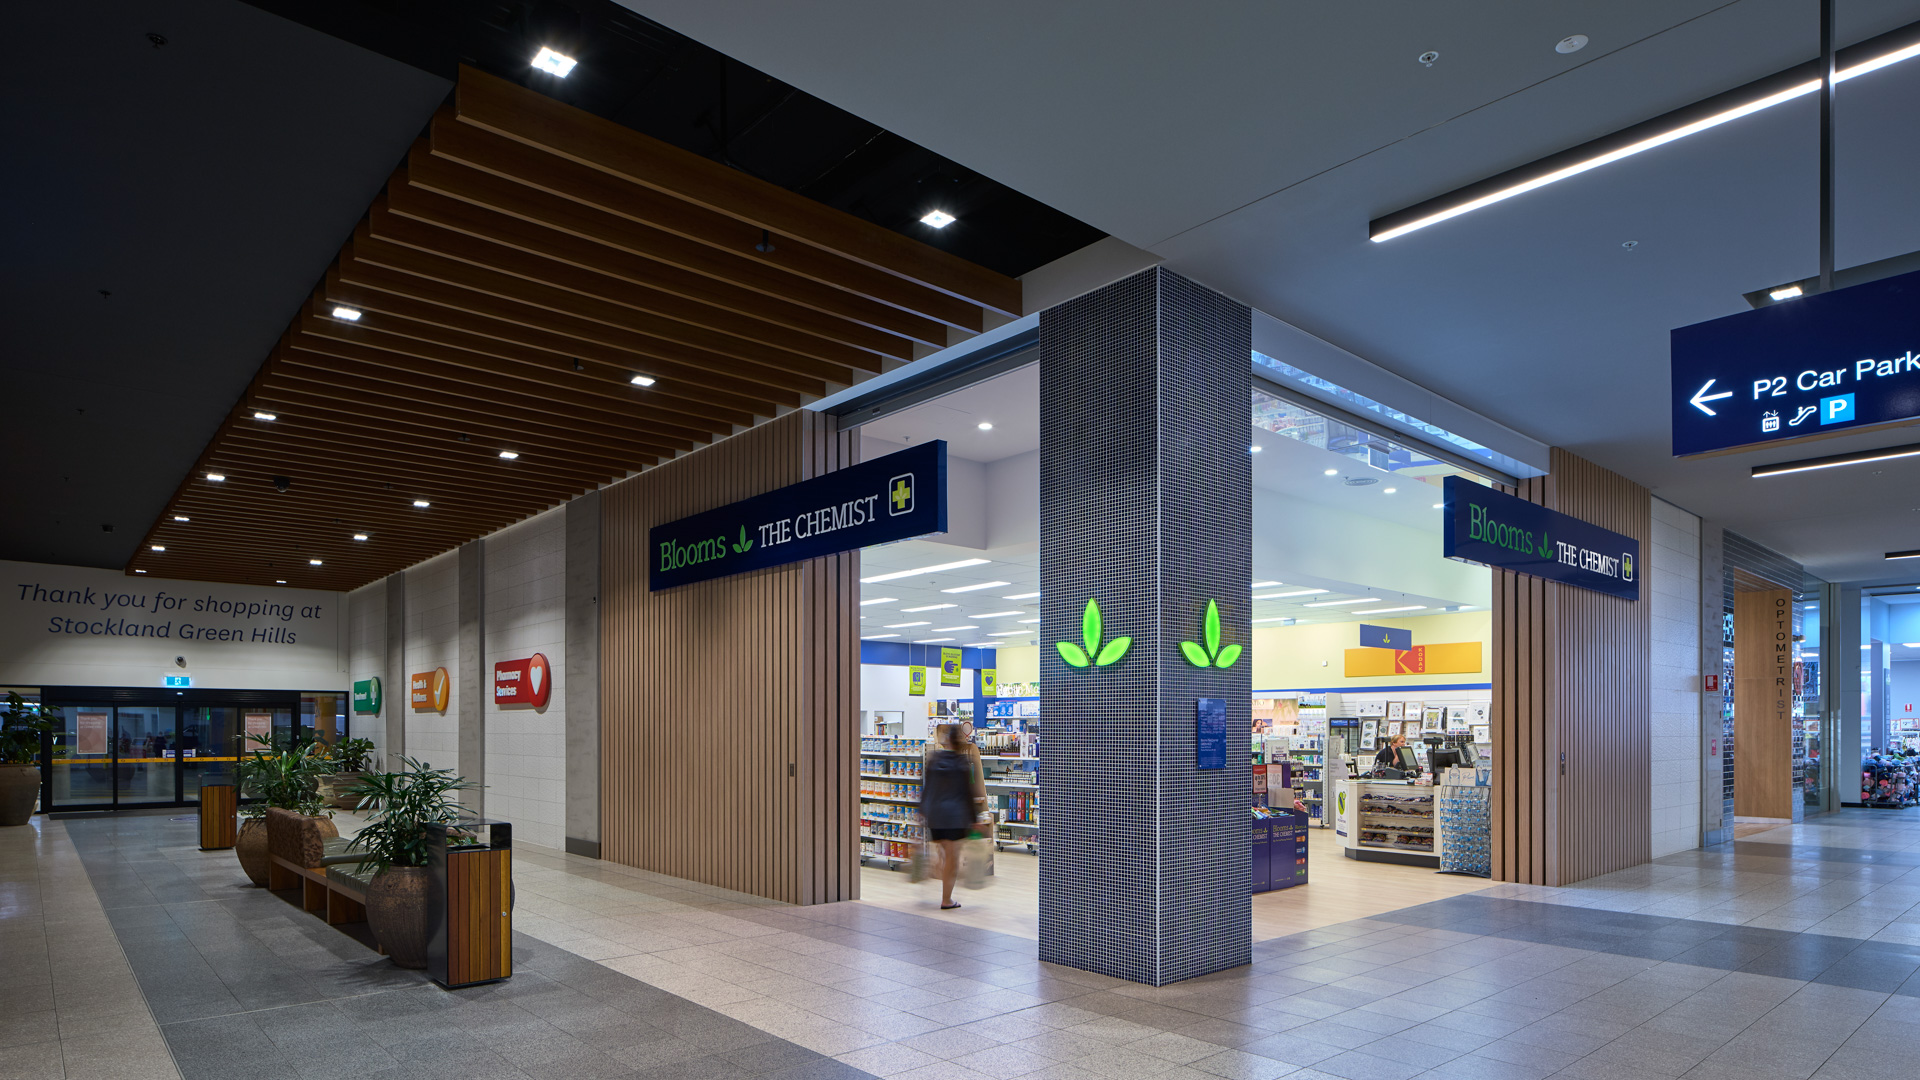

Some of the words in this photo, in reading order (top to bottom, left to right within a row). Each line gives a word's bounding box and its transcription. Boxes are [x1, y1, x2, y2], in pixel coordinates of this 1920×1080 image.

[1753, 376, 1787, 400] P2
[1796, 368, 1847, 391] Car
[1856, 350, 1920, 381] Park
[659, 536, 726, 572] Blooms
[758, 518, 792, 548] THE
[795, 494, 879, 539] CHEMIST
[1469, 503, 1533, 554] Blooms
[1556, 540, 1577, 567] THE
[1579, 548, 1619, 578] CHEMIST
[18, 583, 96, 605] Thank
[100, 593, 146, 611] you
[150, 591, 187, 613] for
[193, 595, 294, 621] shopping
[300, 604, 322, 619] at
[48, 616, 172, 638] Stockland
[179, 623, 244, 642] Green
[251, 627, 297, 644] Hills
[1776, 598, 1786, 720] OPTOMETRIST
